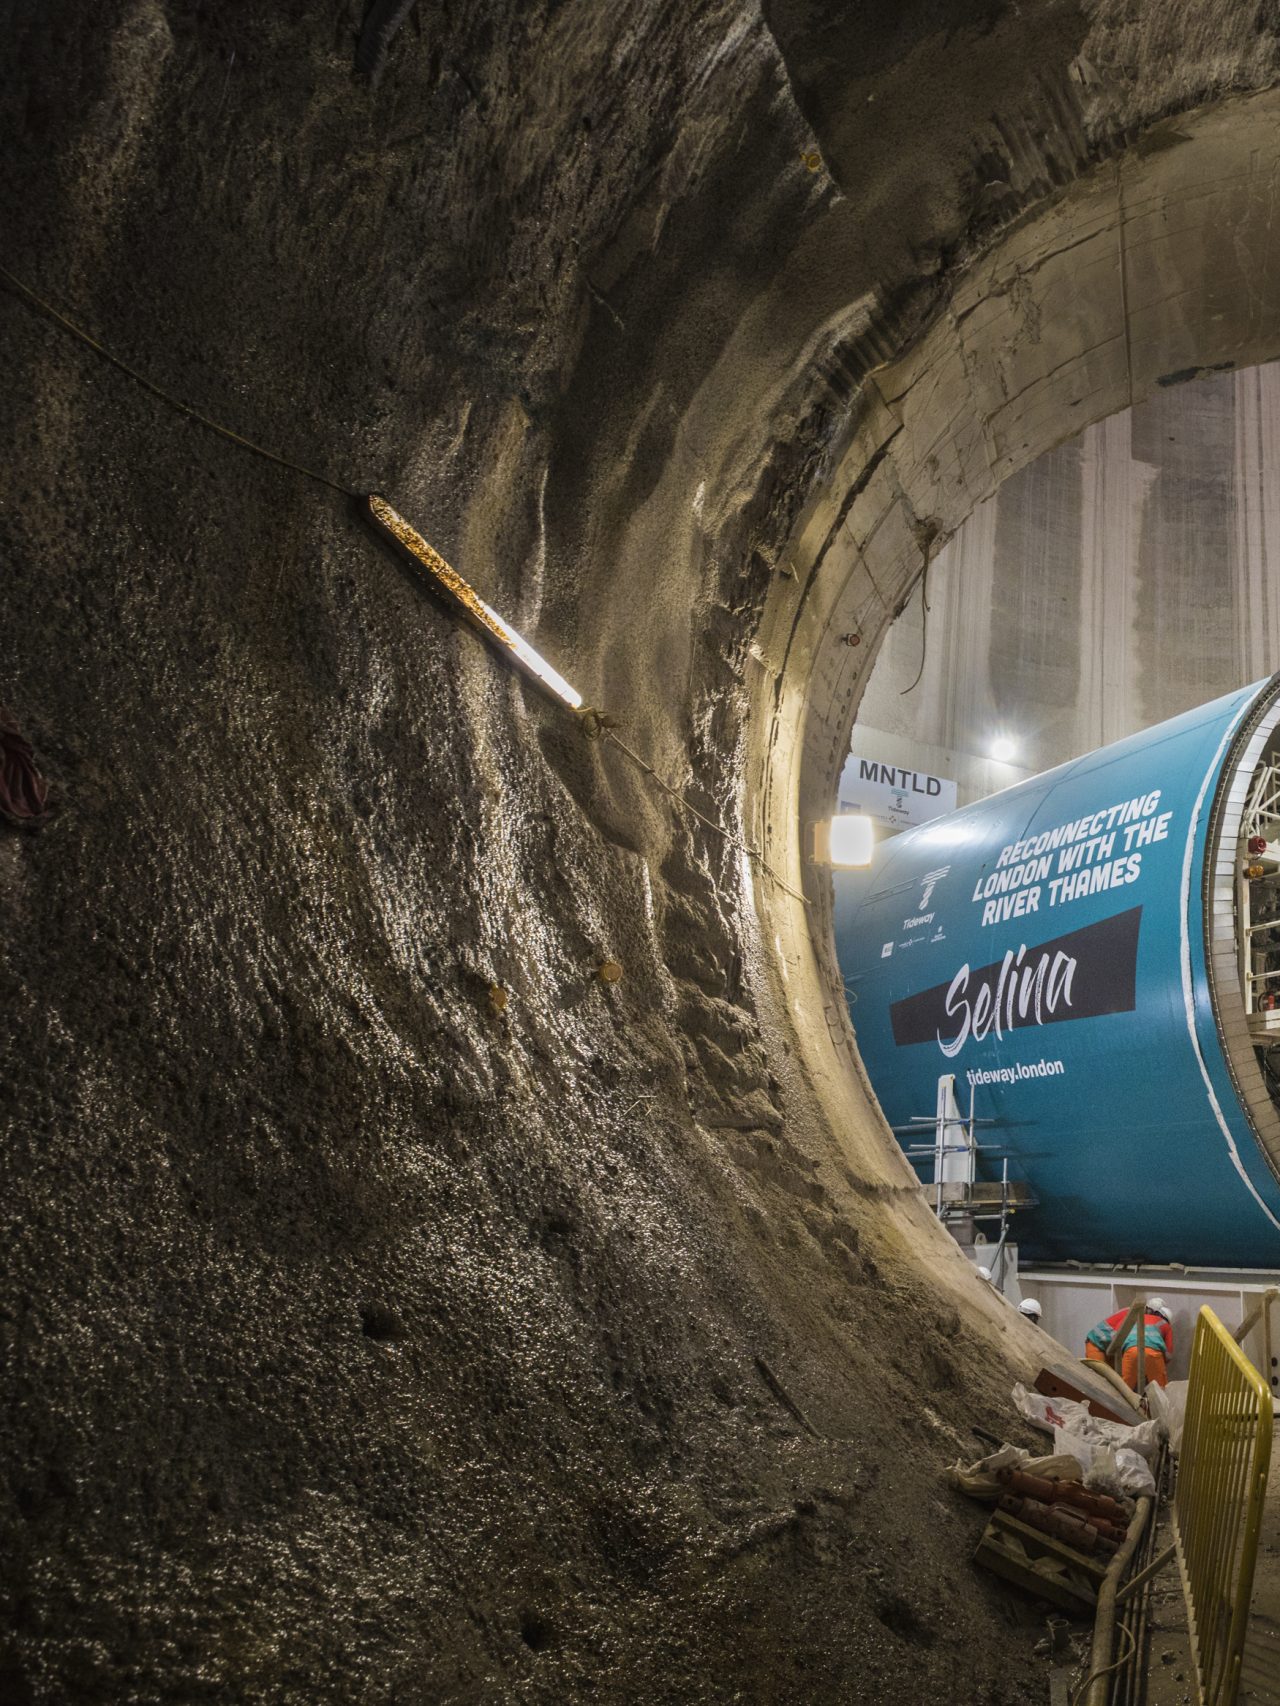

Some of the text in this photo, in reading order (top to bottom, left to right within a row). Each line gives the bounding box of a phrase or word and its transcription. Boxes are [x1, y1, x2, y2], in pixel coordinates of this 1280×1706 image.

[860, 760, 941, 796] MNTLD
[972, 811, 1173, 902] LONDON WITH THE
[996, 789, 1162, 869] RECONNECTING
[903, 912, 935, 930] Tideway
[981, 852, 1142, 927] RIVER THAMES
[937, 943, 1077, 1058] Selina
[966, 1058, 1065, 1086] tideway.london
